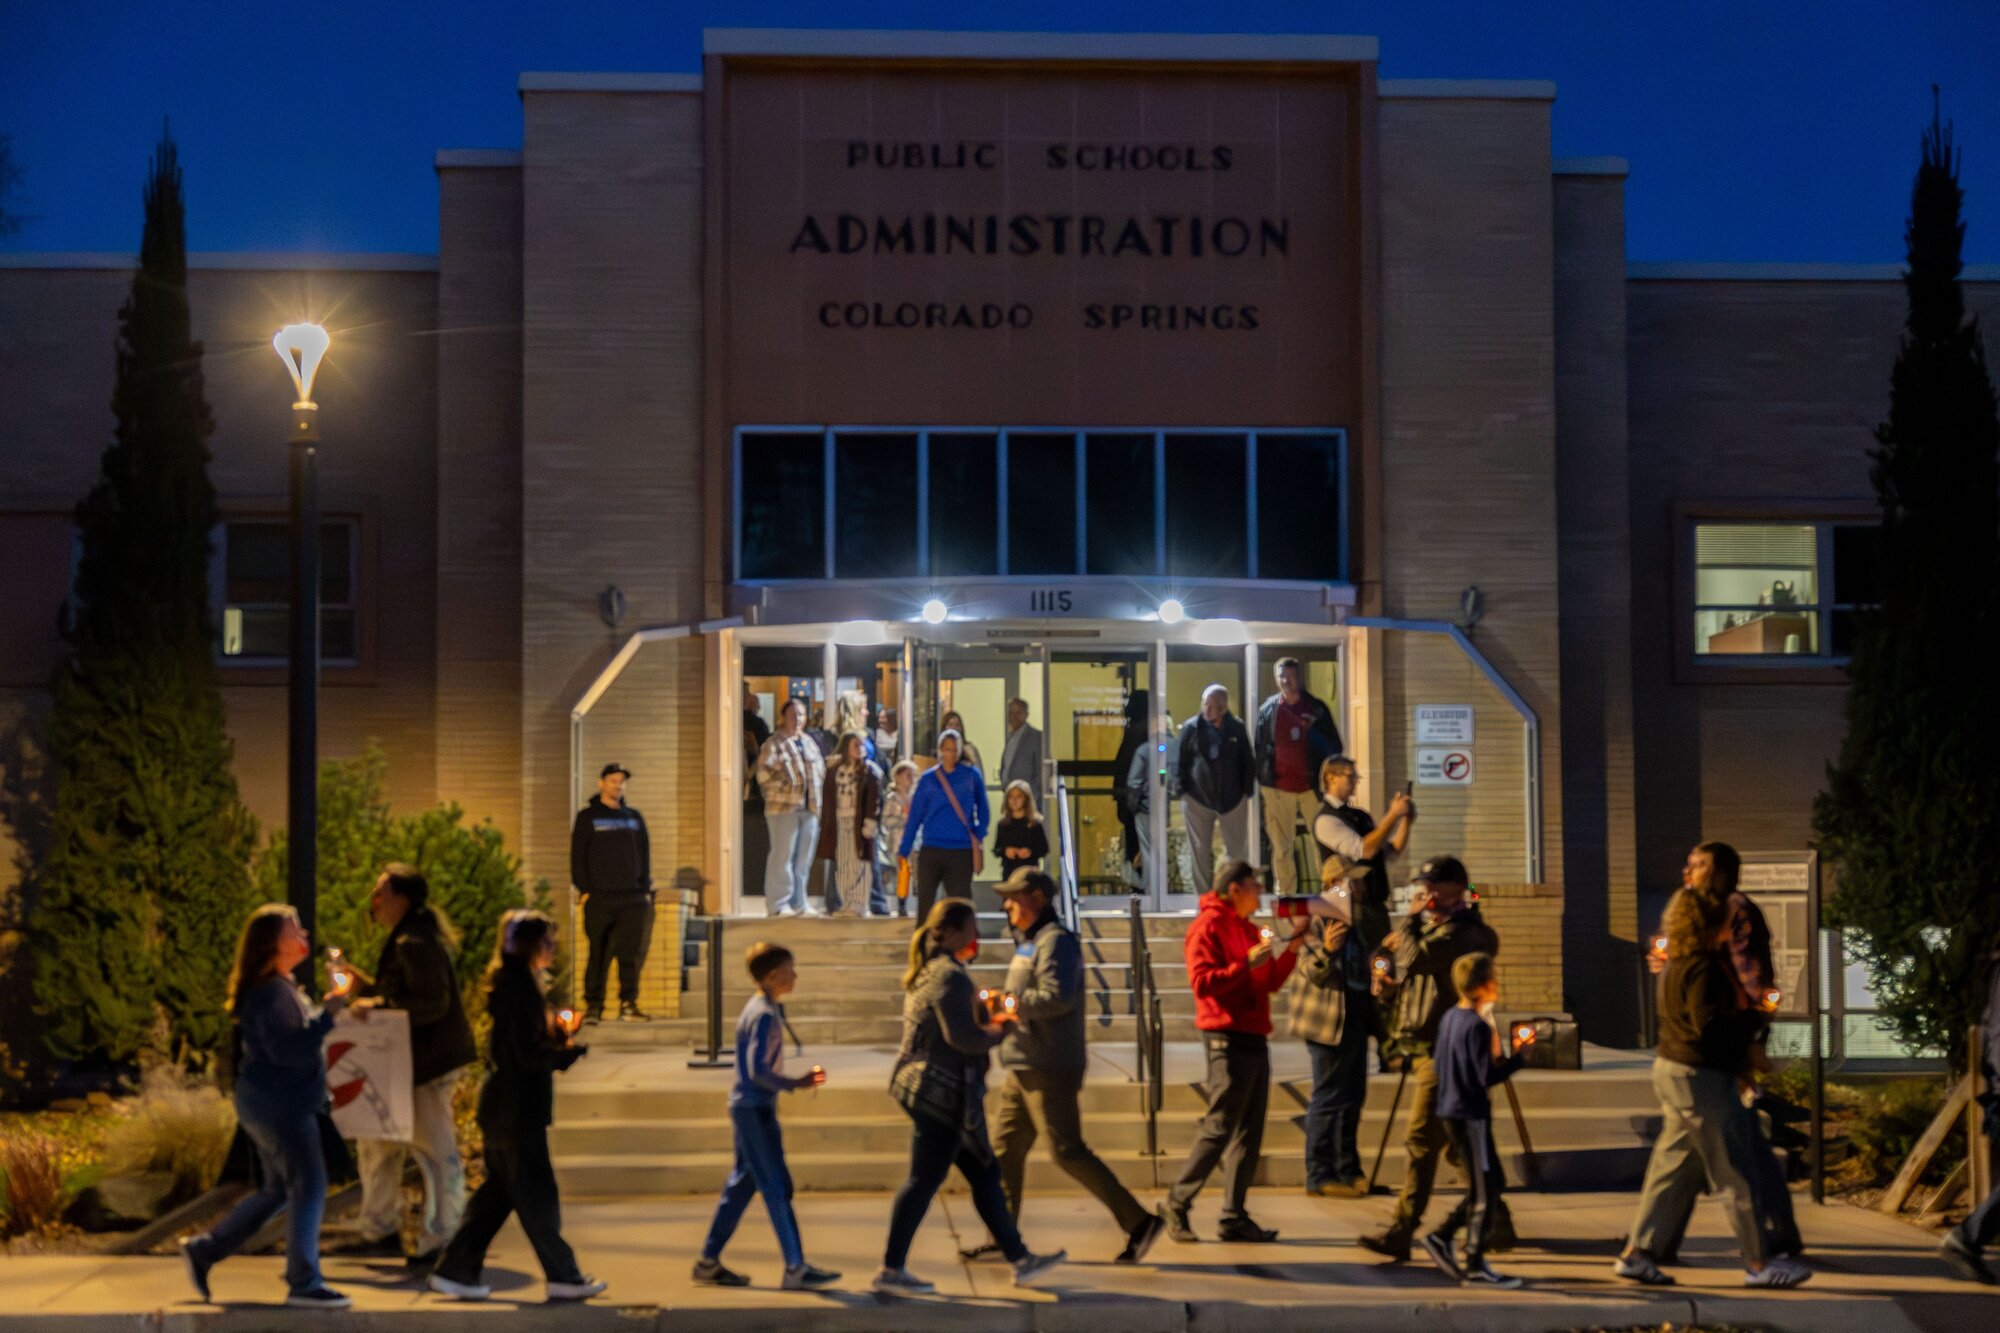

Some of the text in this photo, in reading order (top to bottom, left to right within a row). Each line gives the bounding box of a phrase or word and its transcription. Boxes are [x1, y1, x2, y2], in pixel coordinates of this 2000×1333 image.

[847, 141, 1233, 171] PUBLIC SCHOOLS
[789, 213, 1290, 257] ADMINISTRATION
[818, 302, 1260, 330] COLORADO SPRINGS
[1031, 590, 1072, 612] 1115
